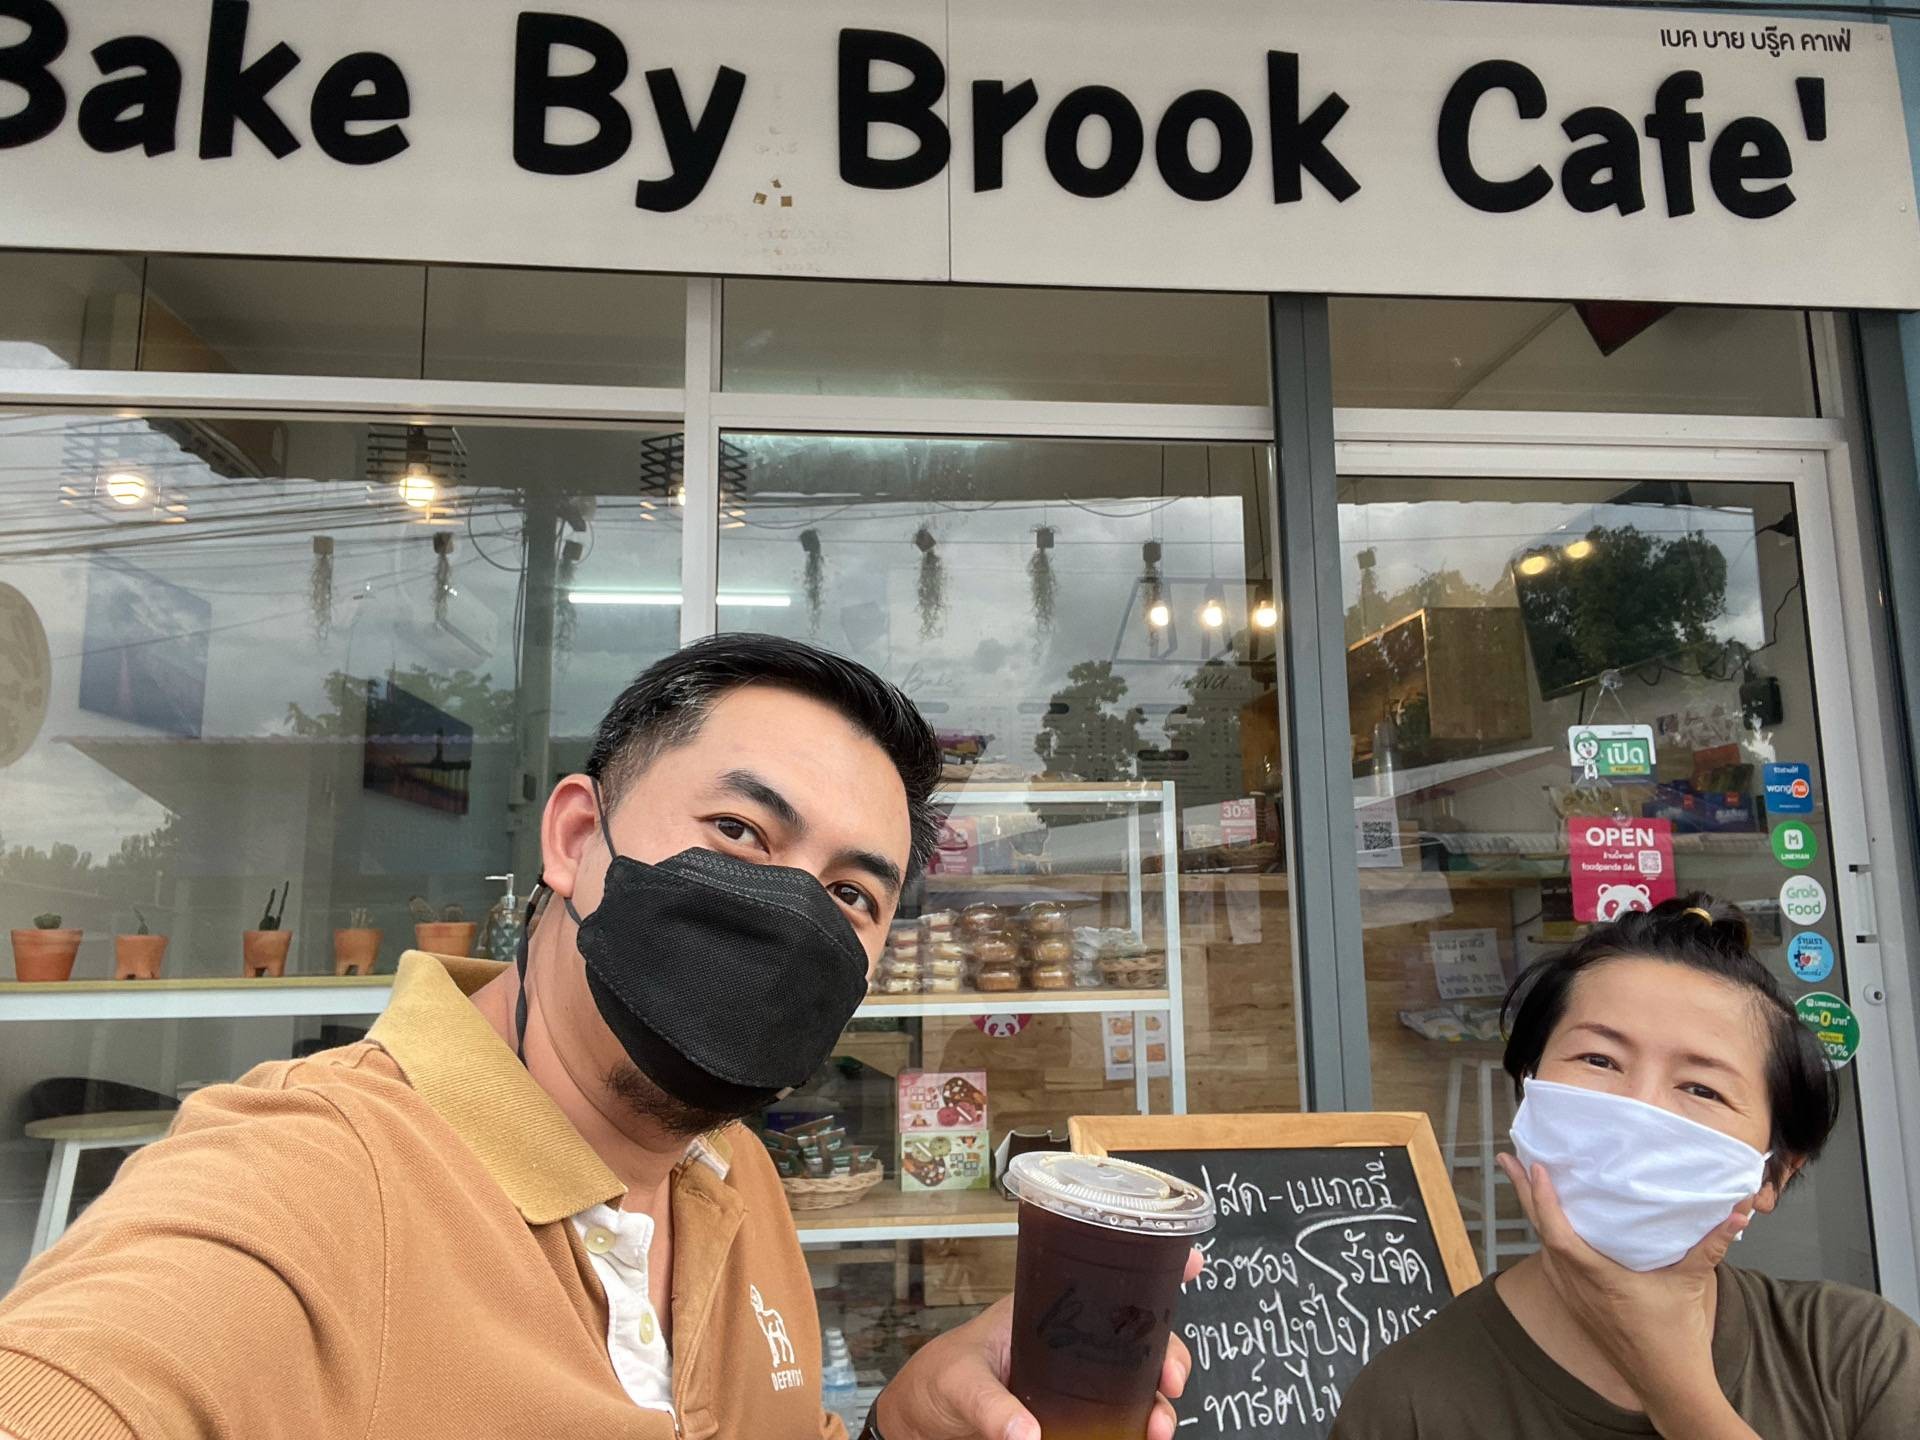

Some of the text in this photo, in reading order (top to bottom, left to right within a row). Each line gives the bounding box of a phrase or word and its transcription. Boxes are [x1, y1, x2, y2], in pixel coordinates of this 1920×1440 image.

[1660, 29, 1697, 48] เบค
[1703, 30, 1745, 49] บาย
[1801, 28, 1851, 52] คาเฟ่
[512, 11, 746, 213] By
[838, 28, 1362, 204] Brook
[1606, 741, 1645, 765] เปิด
[1222, 805, 1250, 819] 30%
[1585, 826, 1655, 847] OPEN
[1786, 885, 1819, 899] Grab
[1787, 901, 1821, 916] Food
[1820, 1010, 1831, 1027] 0
[1181, 1238, 1299, 1294] รัวซอง
[1341, 1229, 1433, 1294] รับจัด
[1184, 1282, 1357, 1370] ขนมปังปิ้ง
